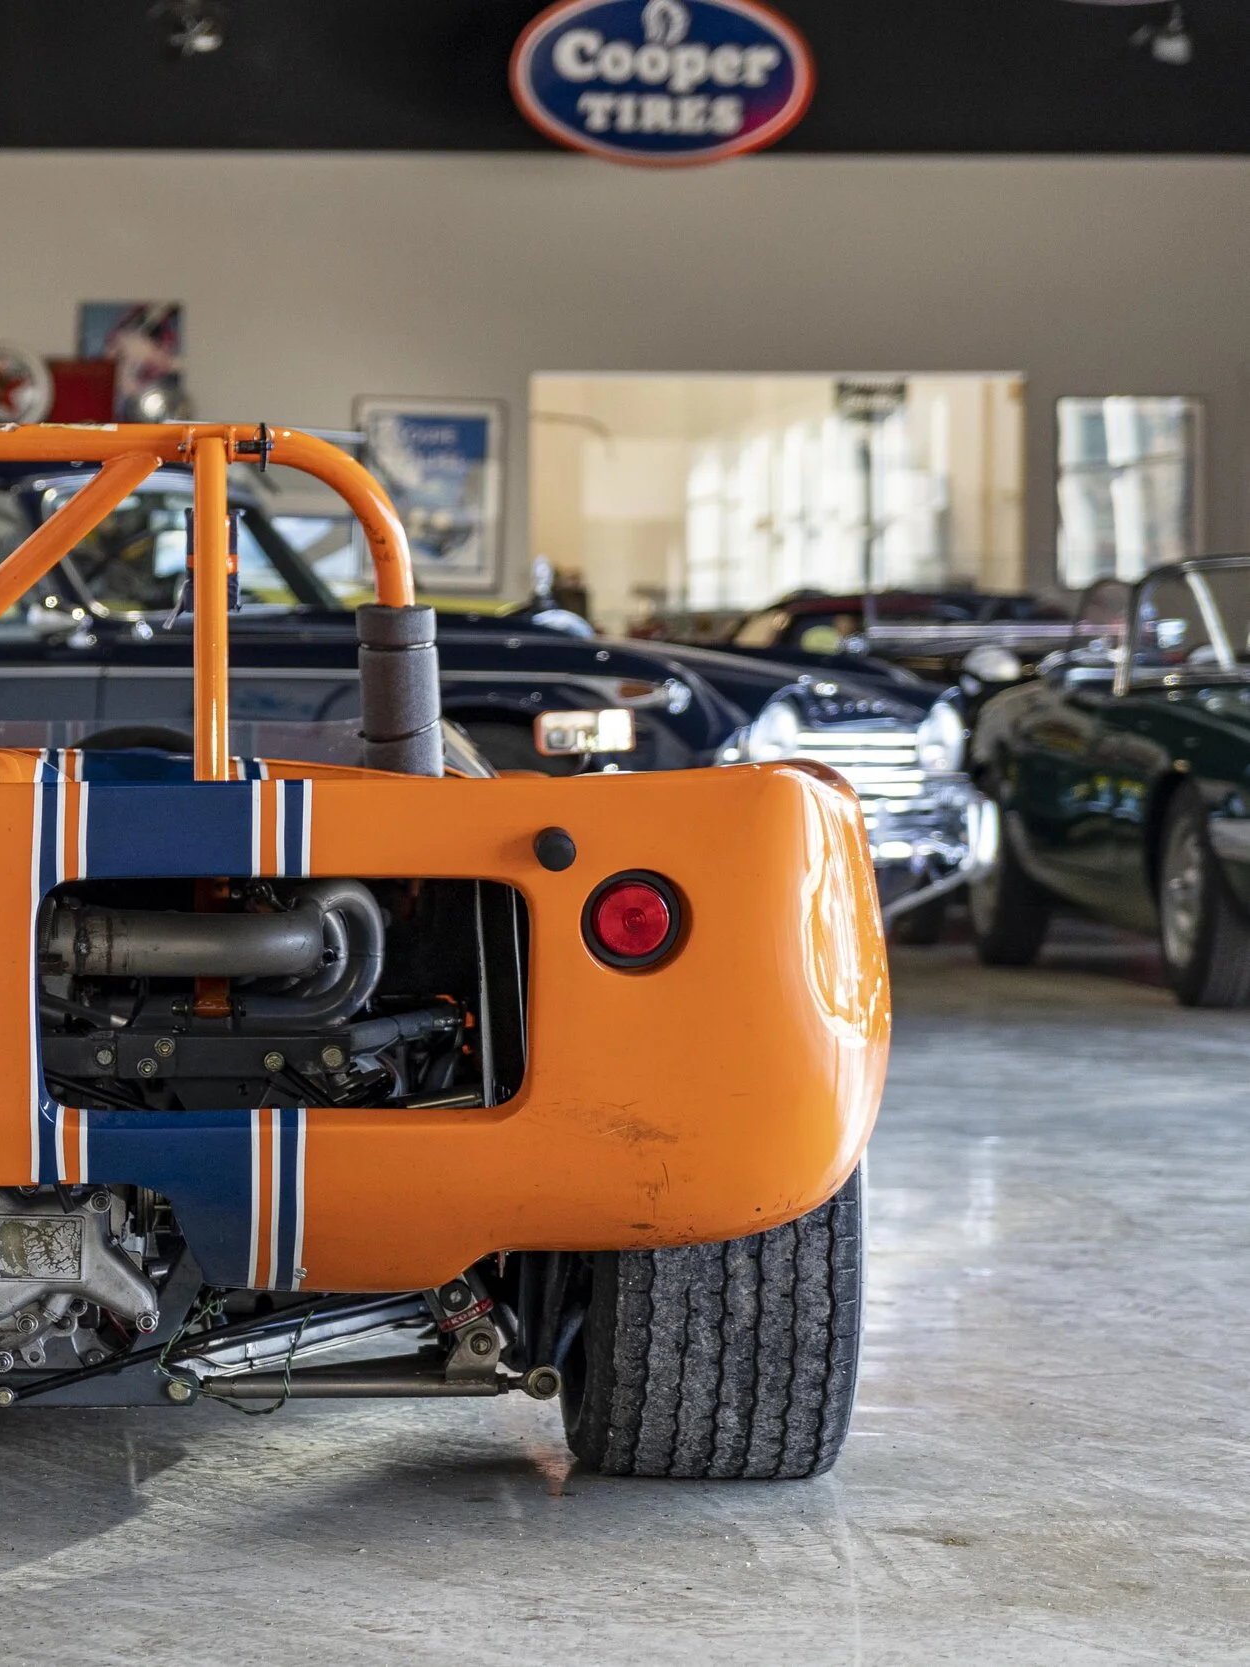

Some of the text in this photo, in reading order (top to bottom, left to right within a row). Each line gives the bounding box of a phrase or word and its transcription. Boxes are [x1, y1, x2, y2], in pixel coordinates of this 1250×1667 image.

[553, 30, 780, 91] Cooper
[579, 93, 742, 134] TIRES
[450, 1306, 480, 1324] KONI
